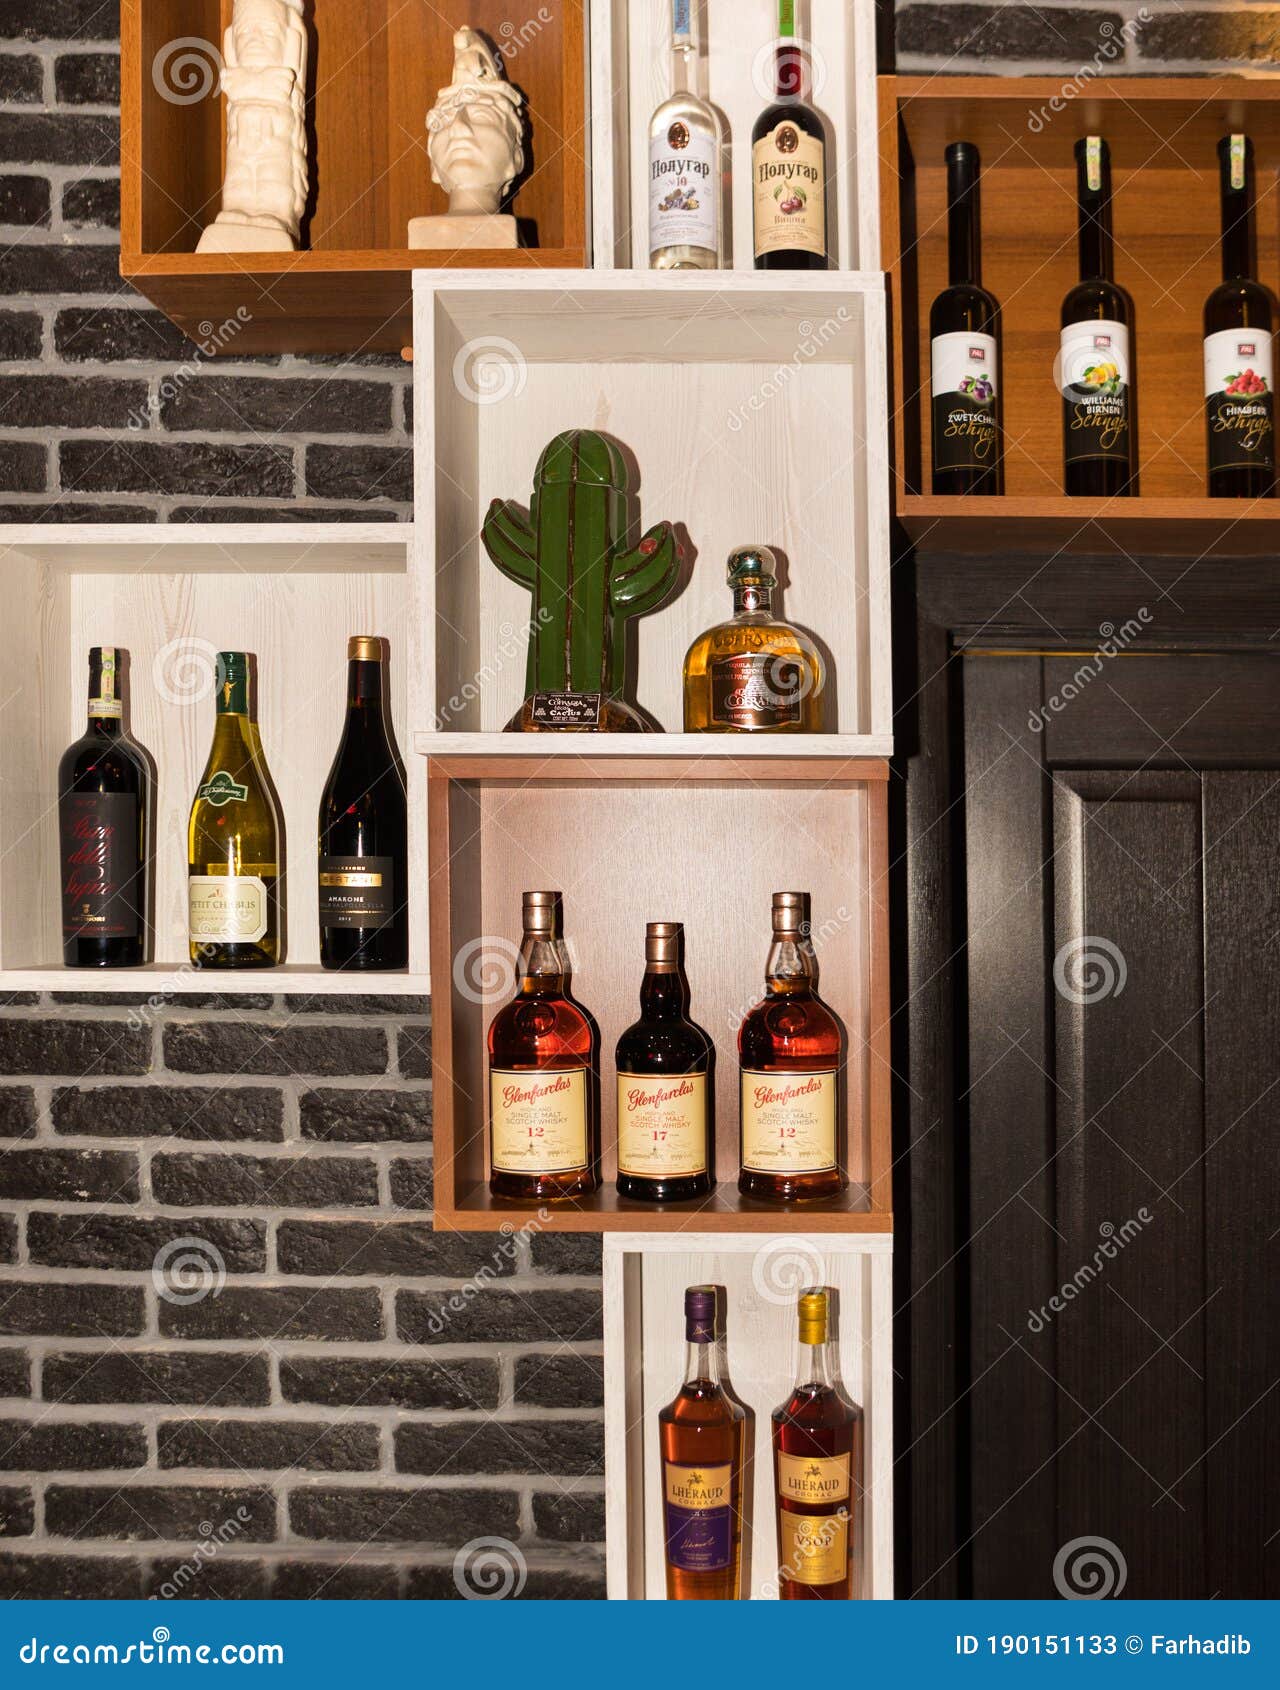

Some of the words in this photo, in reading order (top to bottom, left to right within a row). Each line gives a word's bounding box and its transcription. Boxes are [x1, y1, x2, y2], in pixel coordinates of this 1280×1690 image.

[652, 159, 710, 180] Полугар
[759, 162, 818, 184] Полугар
[1081, 396, 1124, 406] WILLIAMS
[1086, 405, 1120, 414] BIRNEN
[1226, 406, 1266, 416] HIMBEER
[503, 1077, 571, 1108] Glenfarclas
[627, 1080, 694, 1111] Glenfarclas
[754, 1077, 822, 1109] Glenfarclas
[527, 1127, 545, 1137] 12
[652, 1131, 667, 1141] 17
[779, 1127, 796, 1138] 12
[788, 1477, 839, 1491] LHERAUD
[672, 1484, 723, 1499] LHERAUD
